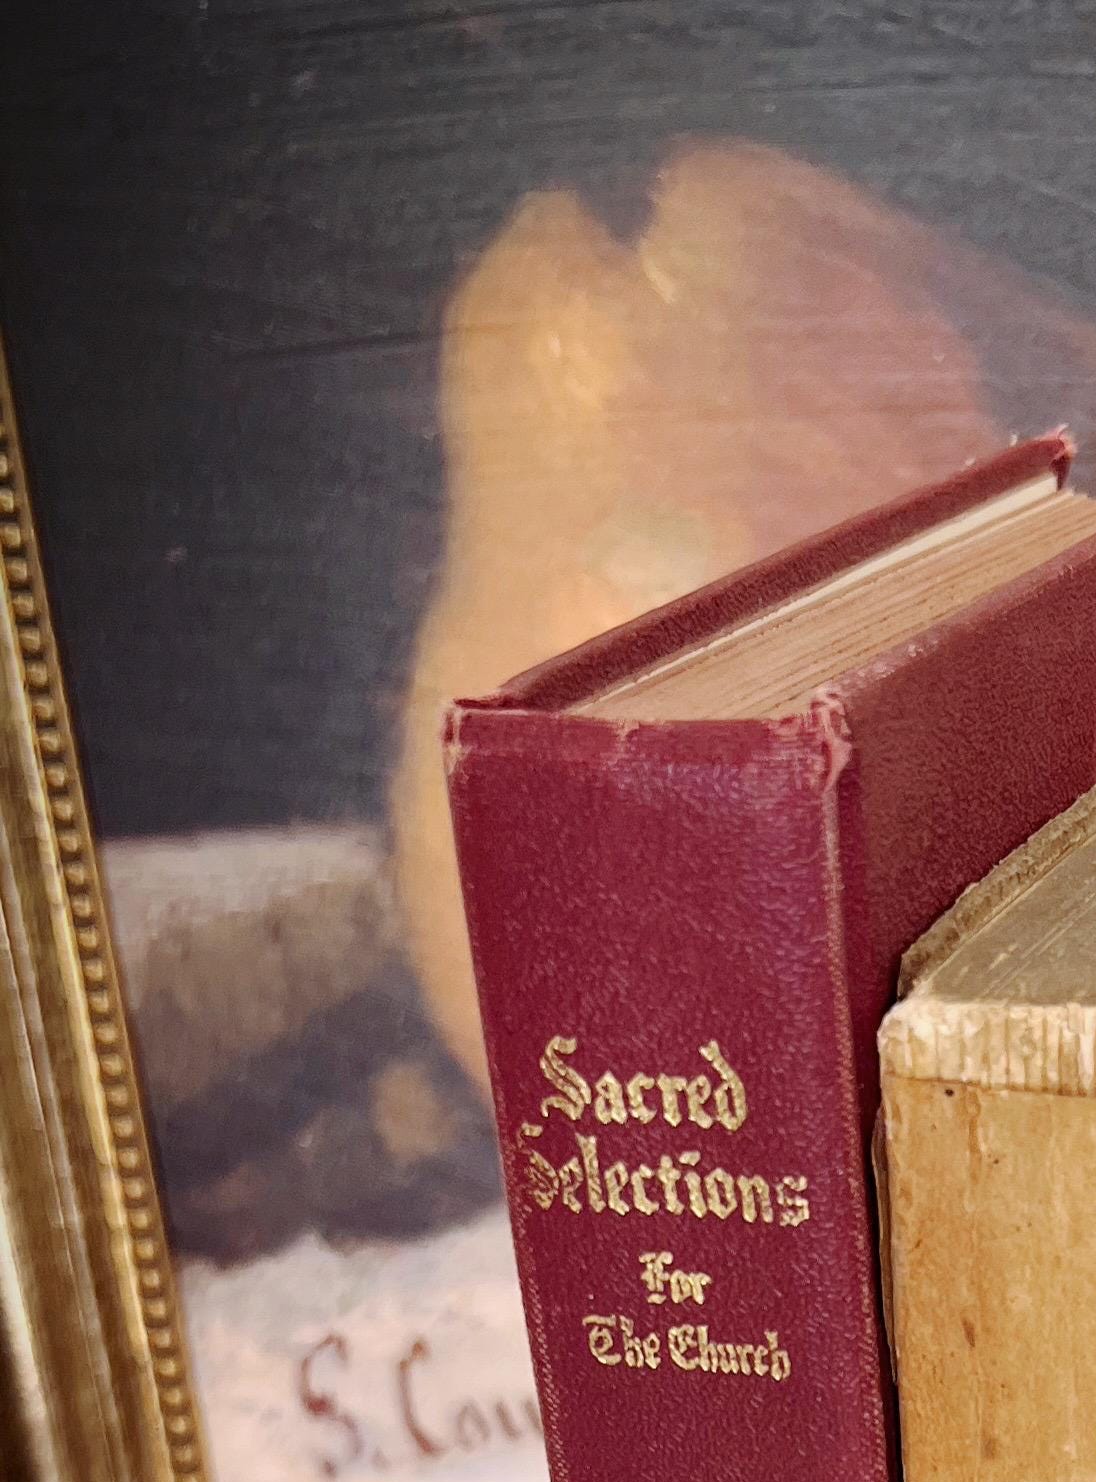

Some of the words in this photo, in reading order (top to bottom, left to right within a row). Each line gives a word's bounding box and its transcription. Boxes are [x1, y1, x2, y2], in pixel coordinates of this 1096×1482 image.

[540, 1035, 748, 1132] Sacred
[518, 1122, 810, 1227] Selections
[638, 1251, 712, 1305] For
[582, 1314, 661, 1370] The
[668, 1324, 792, 1382] Church
